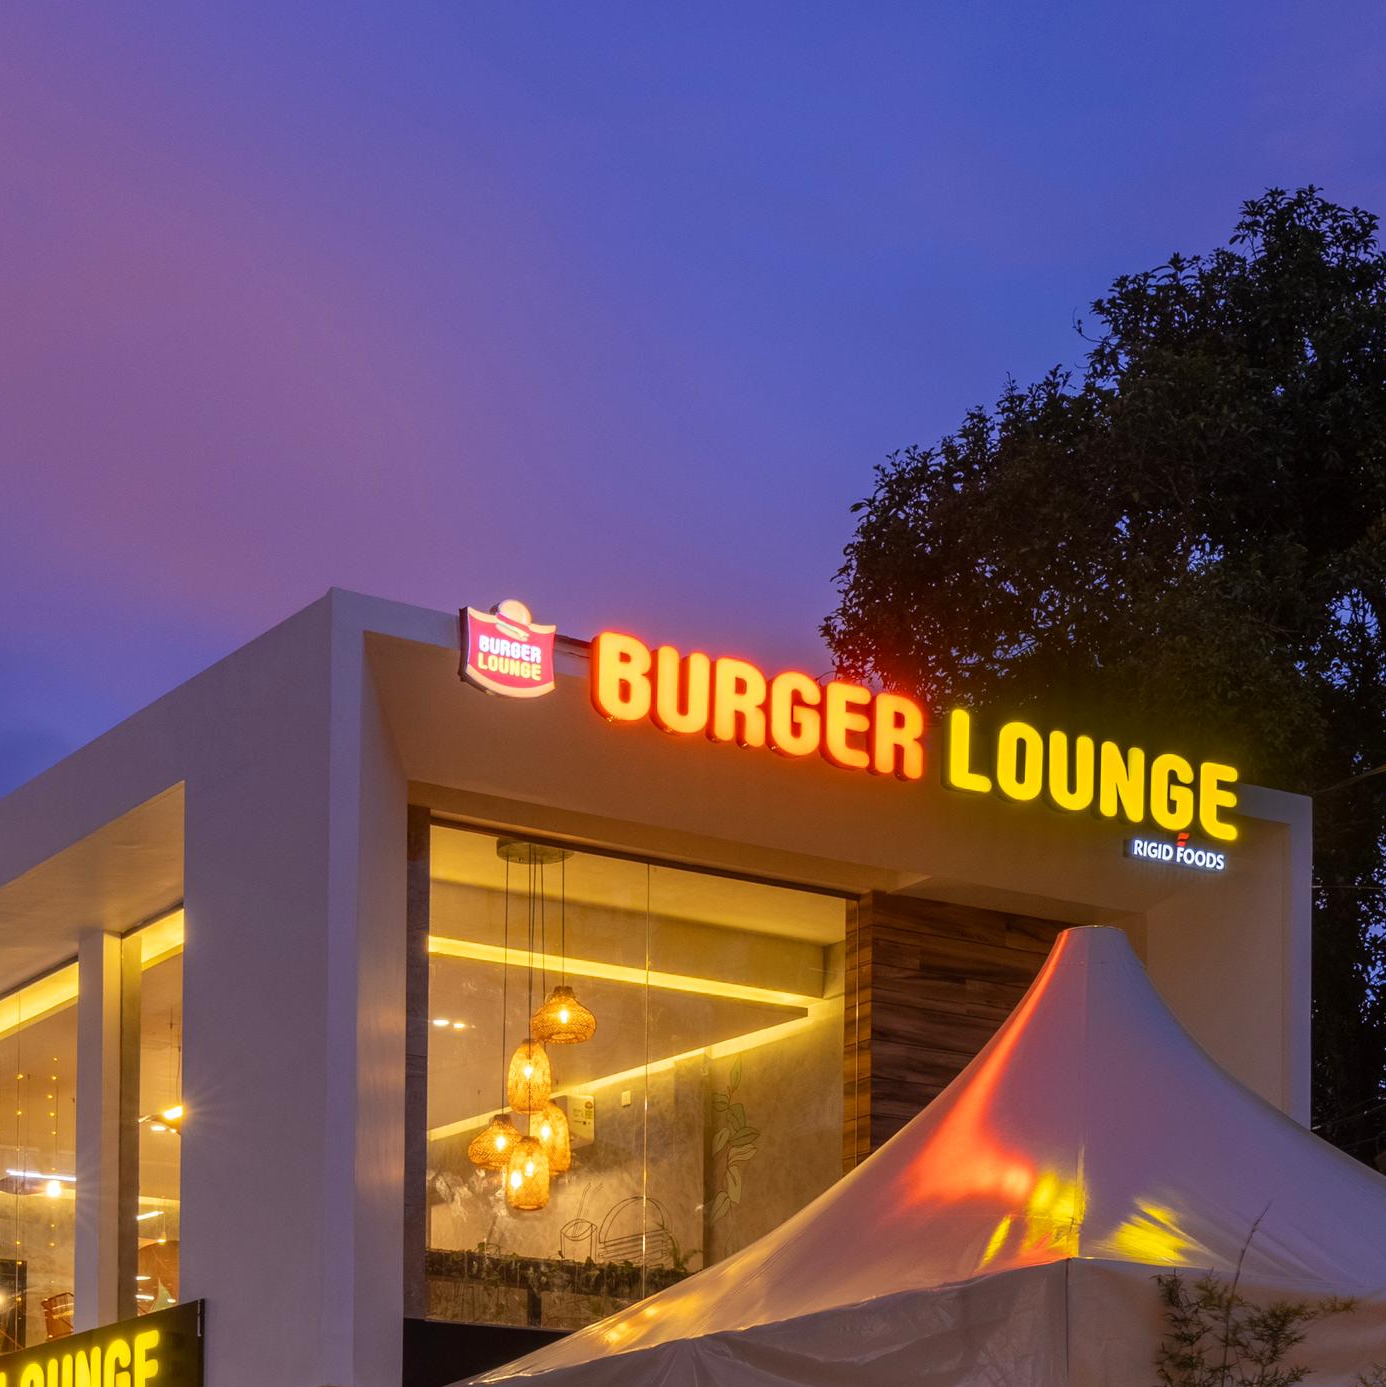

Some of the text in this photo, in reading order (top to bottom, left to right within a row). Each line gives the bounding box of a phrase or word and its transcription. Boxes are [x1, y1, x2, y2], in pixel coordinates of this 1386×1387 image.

[478, 634, 541, 664] BURGER
[477, 652, 542, 682] LOUNGE
[595, 632, 1239, 842] BURGER LOUNGE
[1133, 838, 1225, 870] RIGID FOODS
